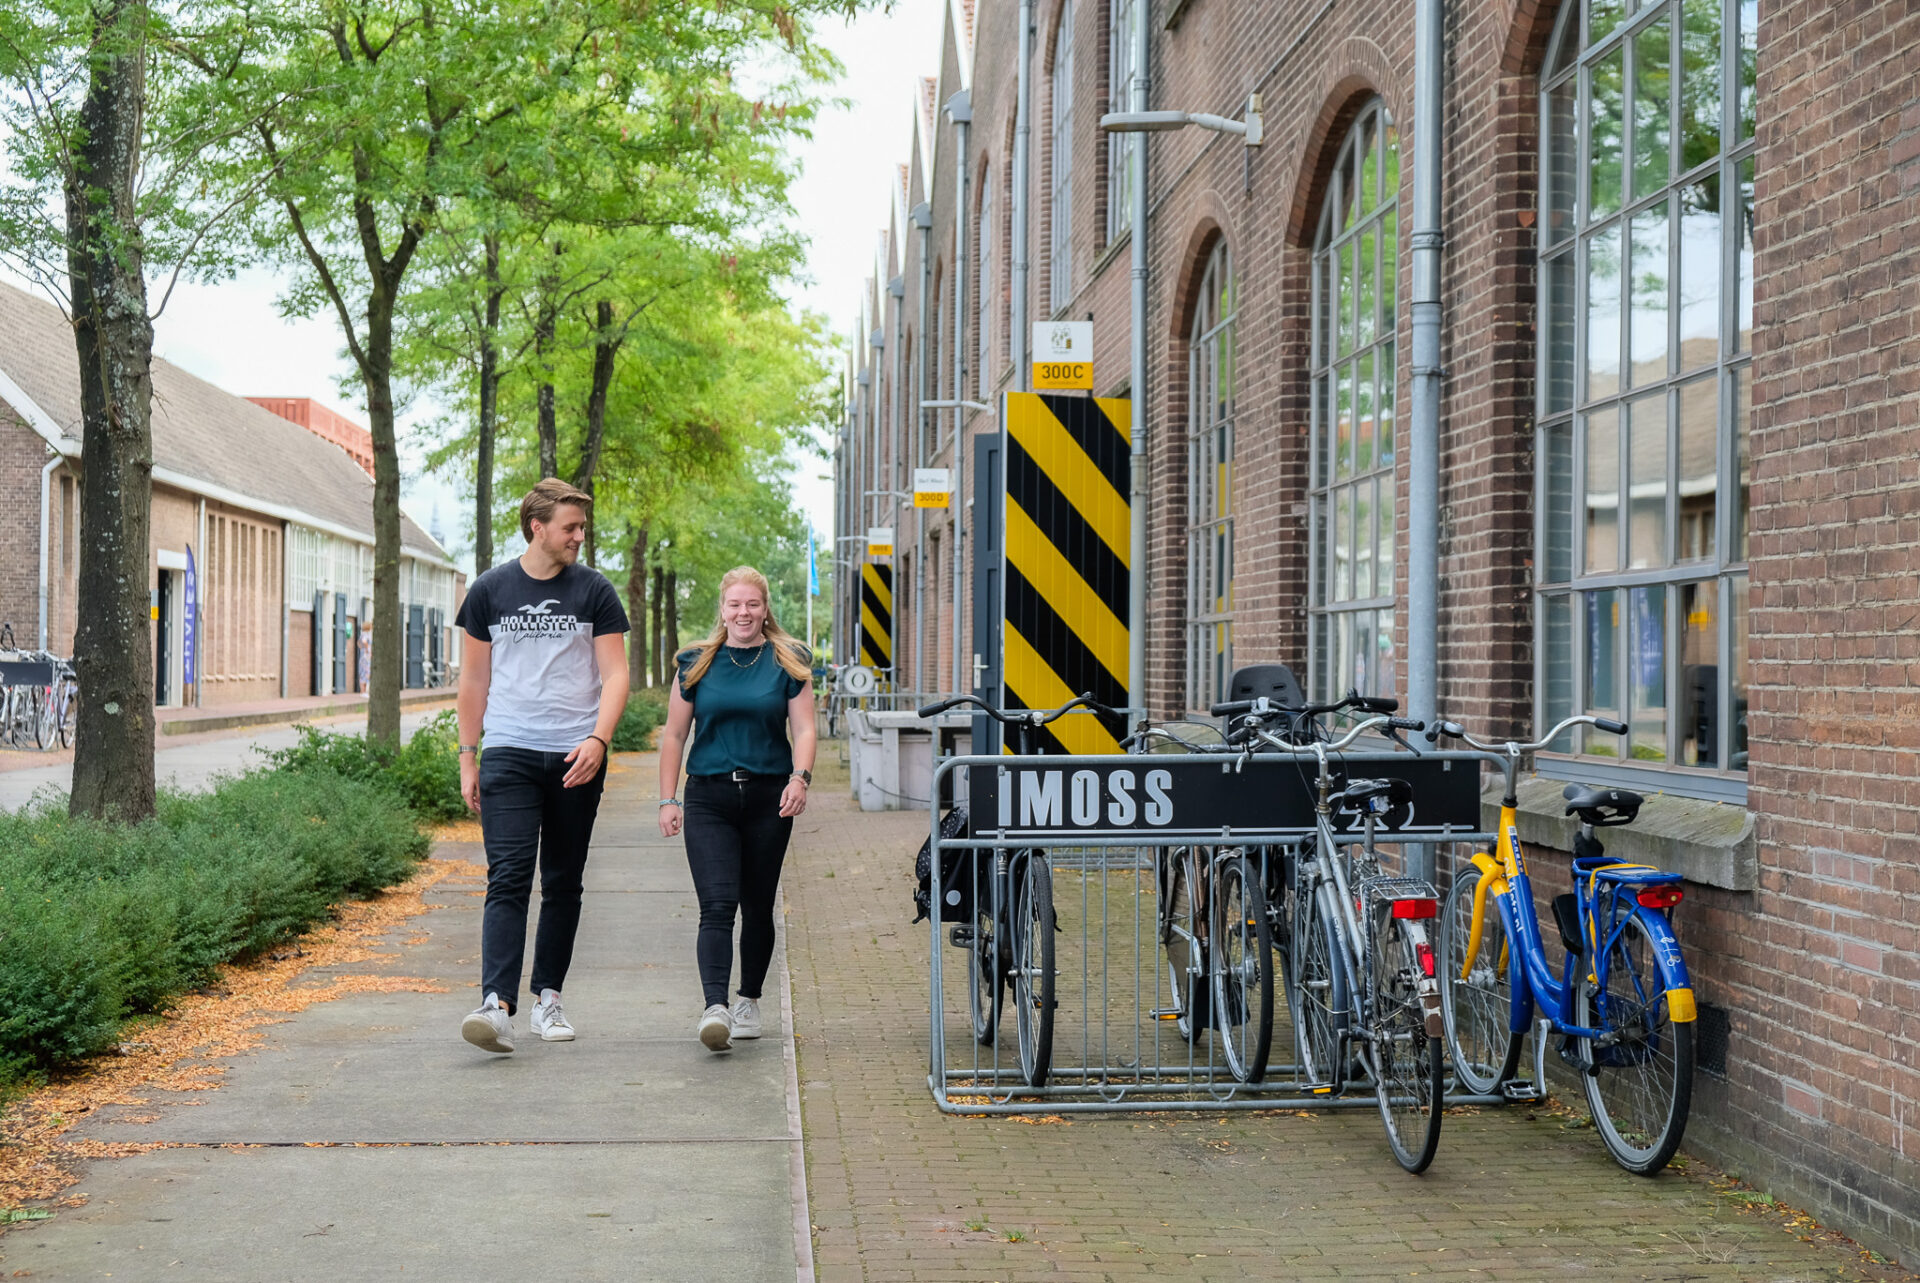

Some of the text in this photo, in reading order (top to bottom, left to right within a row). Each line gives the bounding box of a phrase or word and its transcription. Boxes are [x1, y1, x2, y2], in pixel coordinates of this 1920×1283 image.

[1042, 364, 1084, 379] 300C
[501, 615, 577, 632] HOLLISTER
[513, 628, 563, 644] California
[998, 769, 1173, 826] IMOSS
